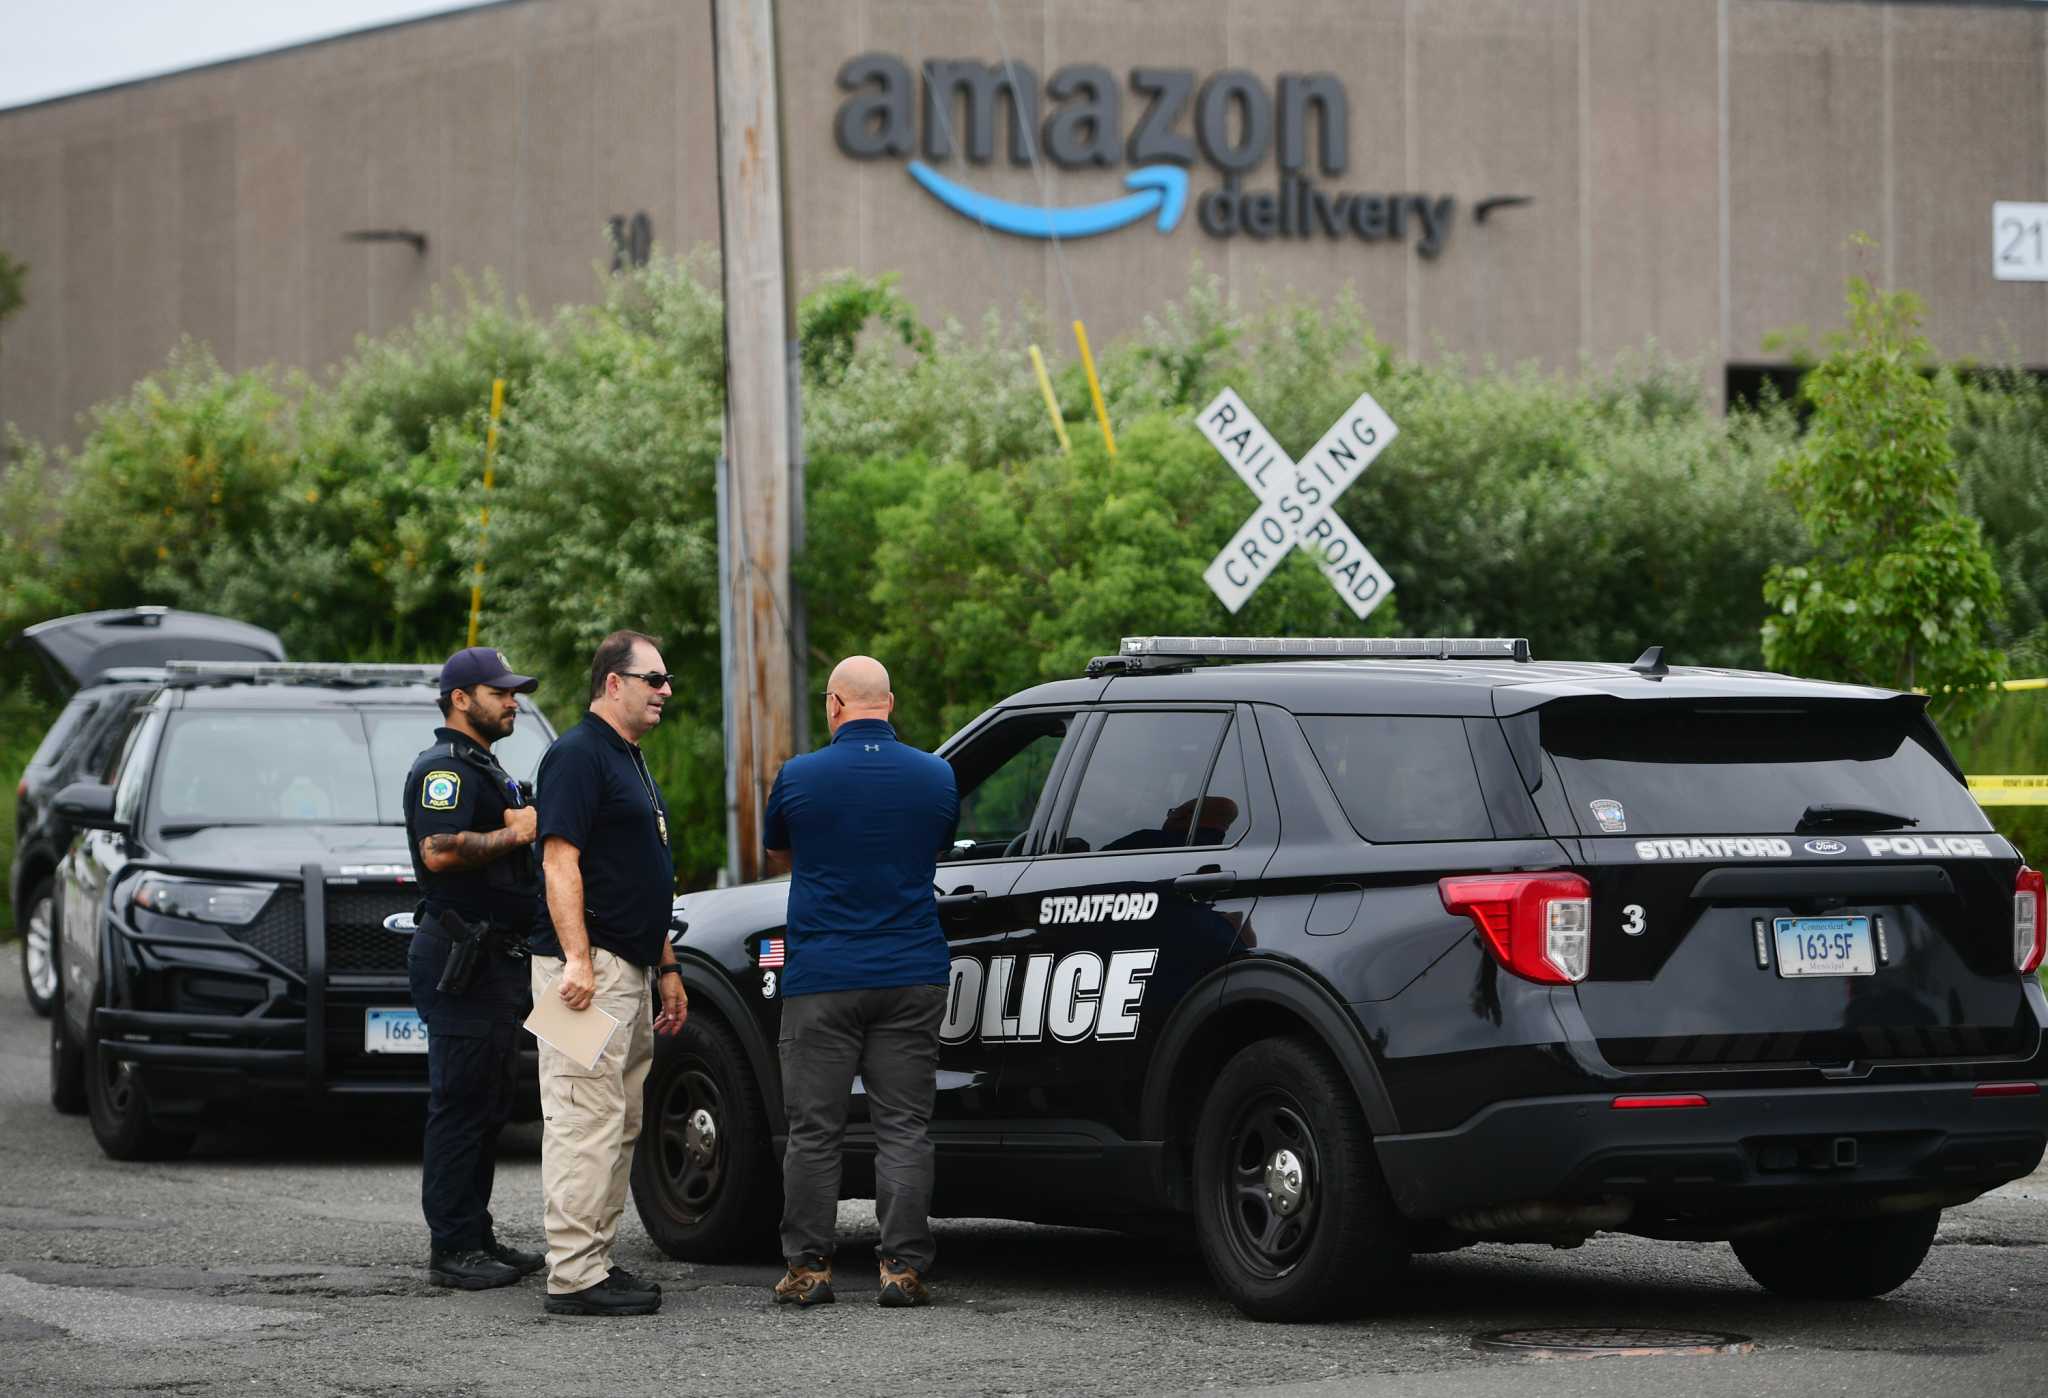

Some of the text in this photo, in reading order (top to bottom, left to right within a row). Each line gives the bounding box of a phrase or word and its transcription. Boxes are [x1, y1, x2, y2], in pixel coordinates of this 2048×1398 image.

[836, 53, 1349, 178] amazon
[1198, 172, 1456, 260] delivery
[1209, 404, 1379, 602] RAIL ROAD
[1223, 417, 1377, 588] CROSSING
[1634, 837, 1993, 861] STRATFORD Ford POLICE
[1039, 892, 1159, 925] STRATFORD
[1621, 903, 1648, 937] 3
[761, 970, 777, 999] 3
[938, 948, 1160, 1045] OLICE
[385, 1021, 427, 1040] 166·S
